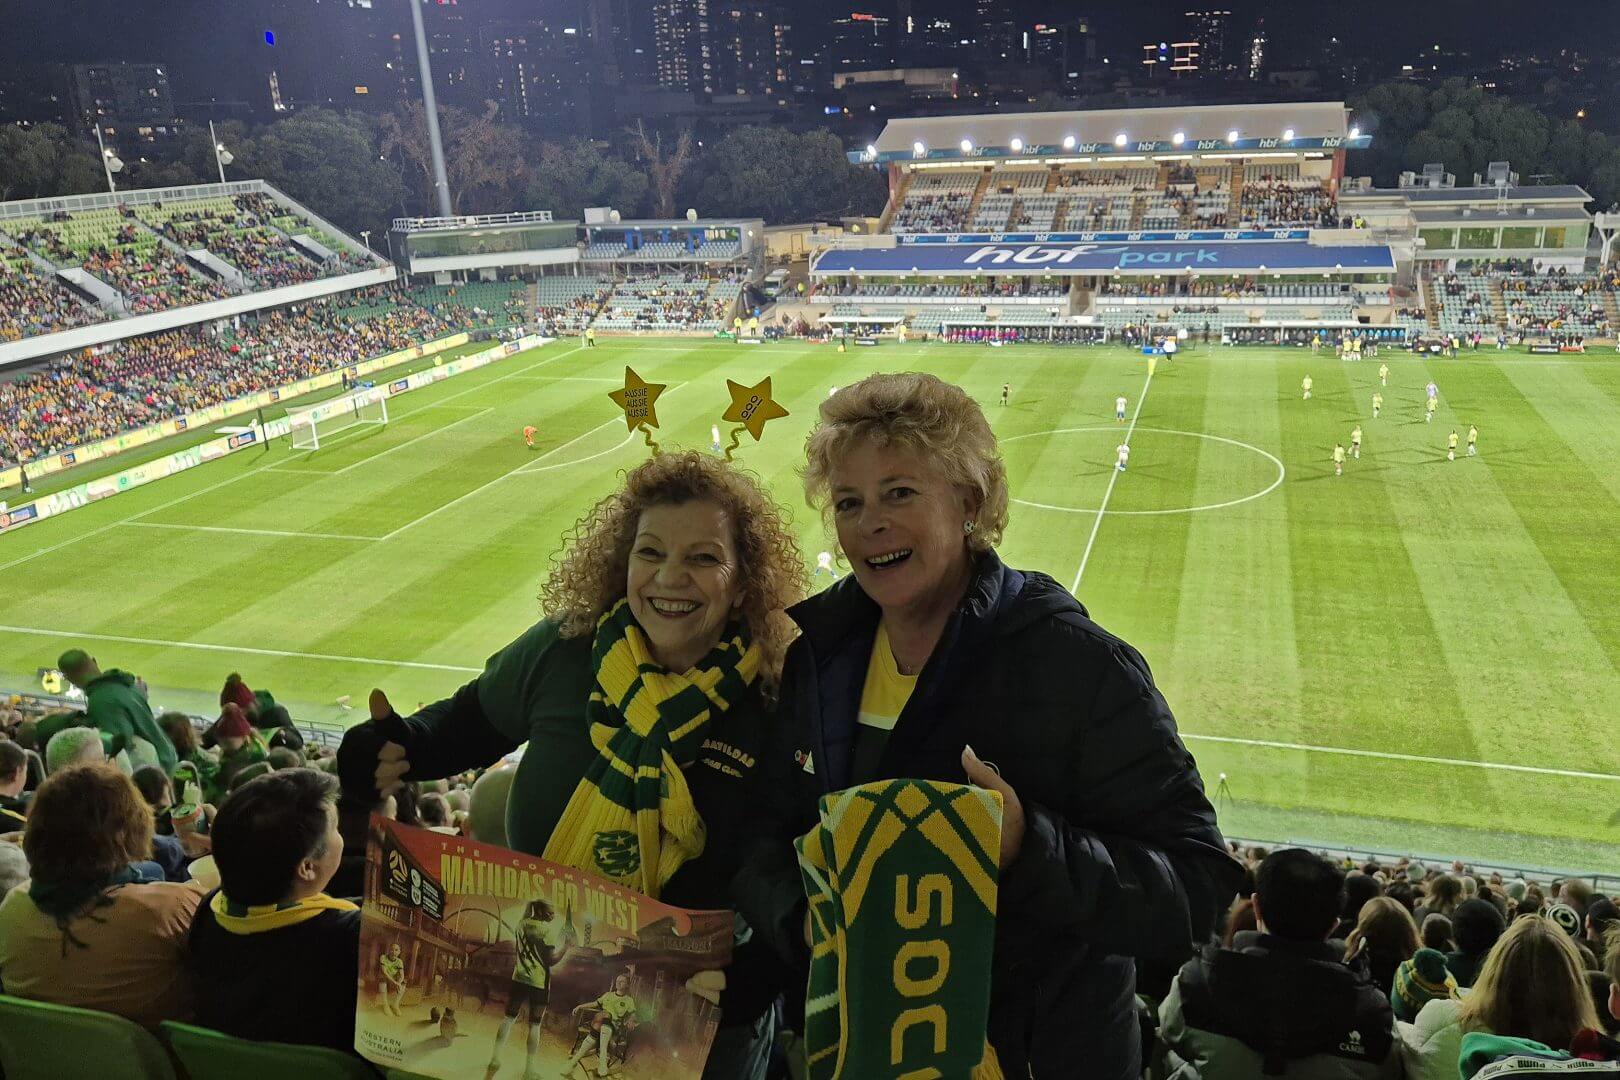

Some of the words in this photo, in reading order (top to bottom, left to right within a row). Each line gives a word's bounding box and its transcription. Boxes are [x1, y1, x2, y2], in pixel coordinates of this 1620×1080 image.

[1138, 141, 1156, 151] hbf
[1197, 140, 1216, 150] hbf
[1259, 138, 1279, 148] hbf
[1322, 137, 1342, 147] hbf
[1023, 145, 1040, 154] hbf
[1079, 143, 1096, 153] hbf
[963, 245, 1100, 264] hbf
[1118, 249, 1219, 267] park
[625, 387, 648, 398] AUSSIE
[626, 398, 648, 408] AUSSIE
[627, 408, 648, 418] AUSSIE
[441, 842, 480, 857] THE
[440, 853, 545, 900] MATILDAS
[551, 878, 578, 913] GO
[584, 886, 639, 937] WEST
[889, 873, 954, 1080] SOC
[1517, 1059, 1546, 1069] PUMA
